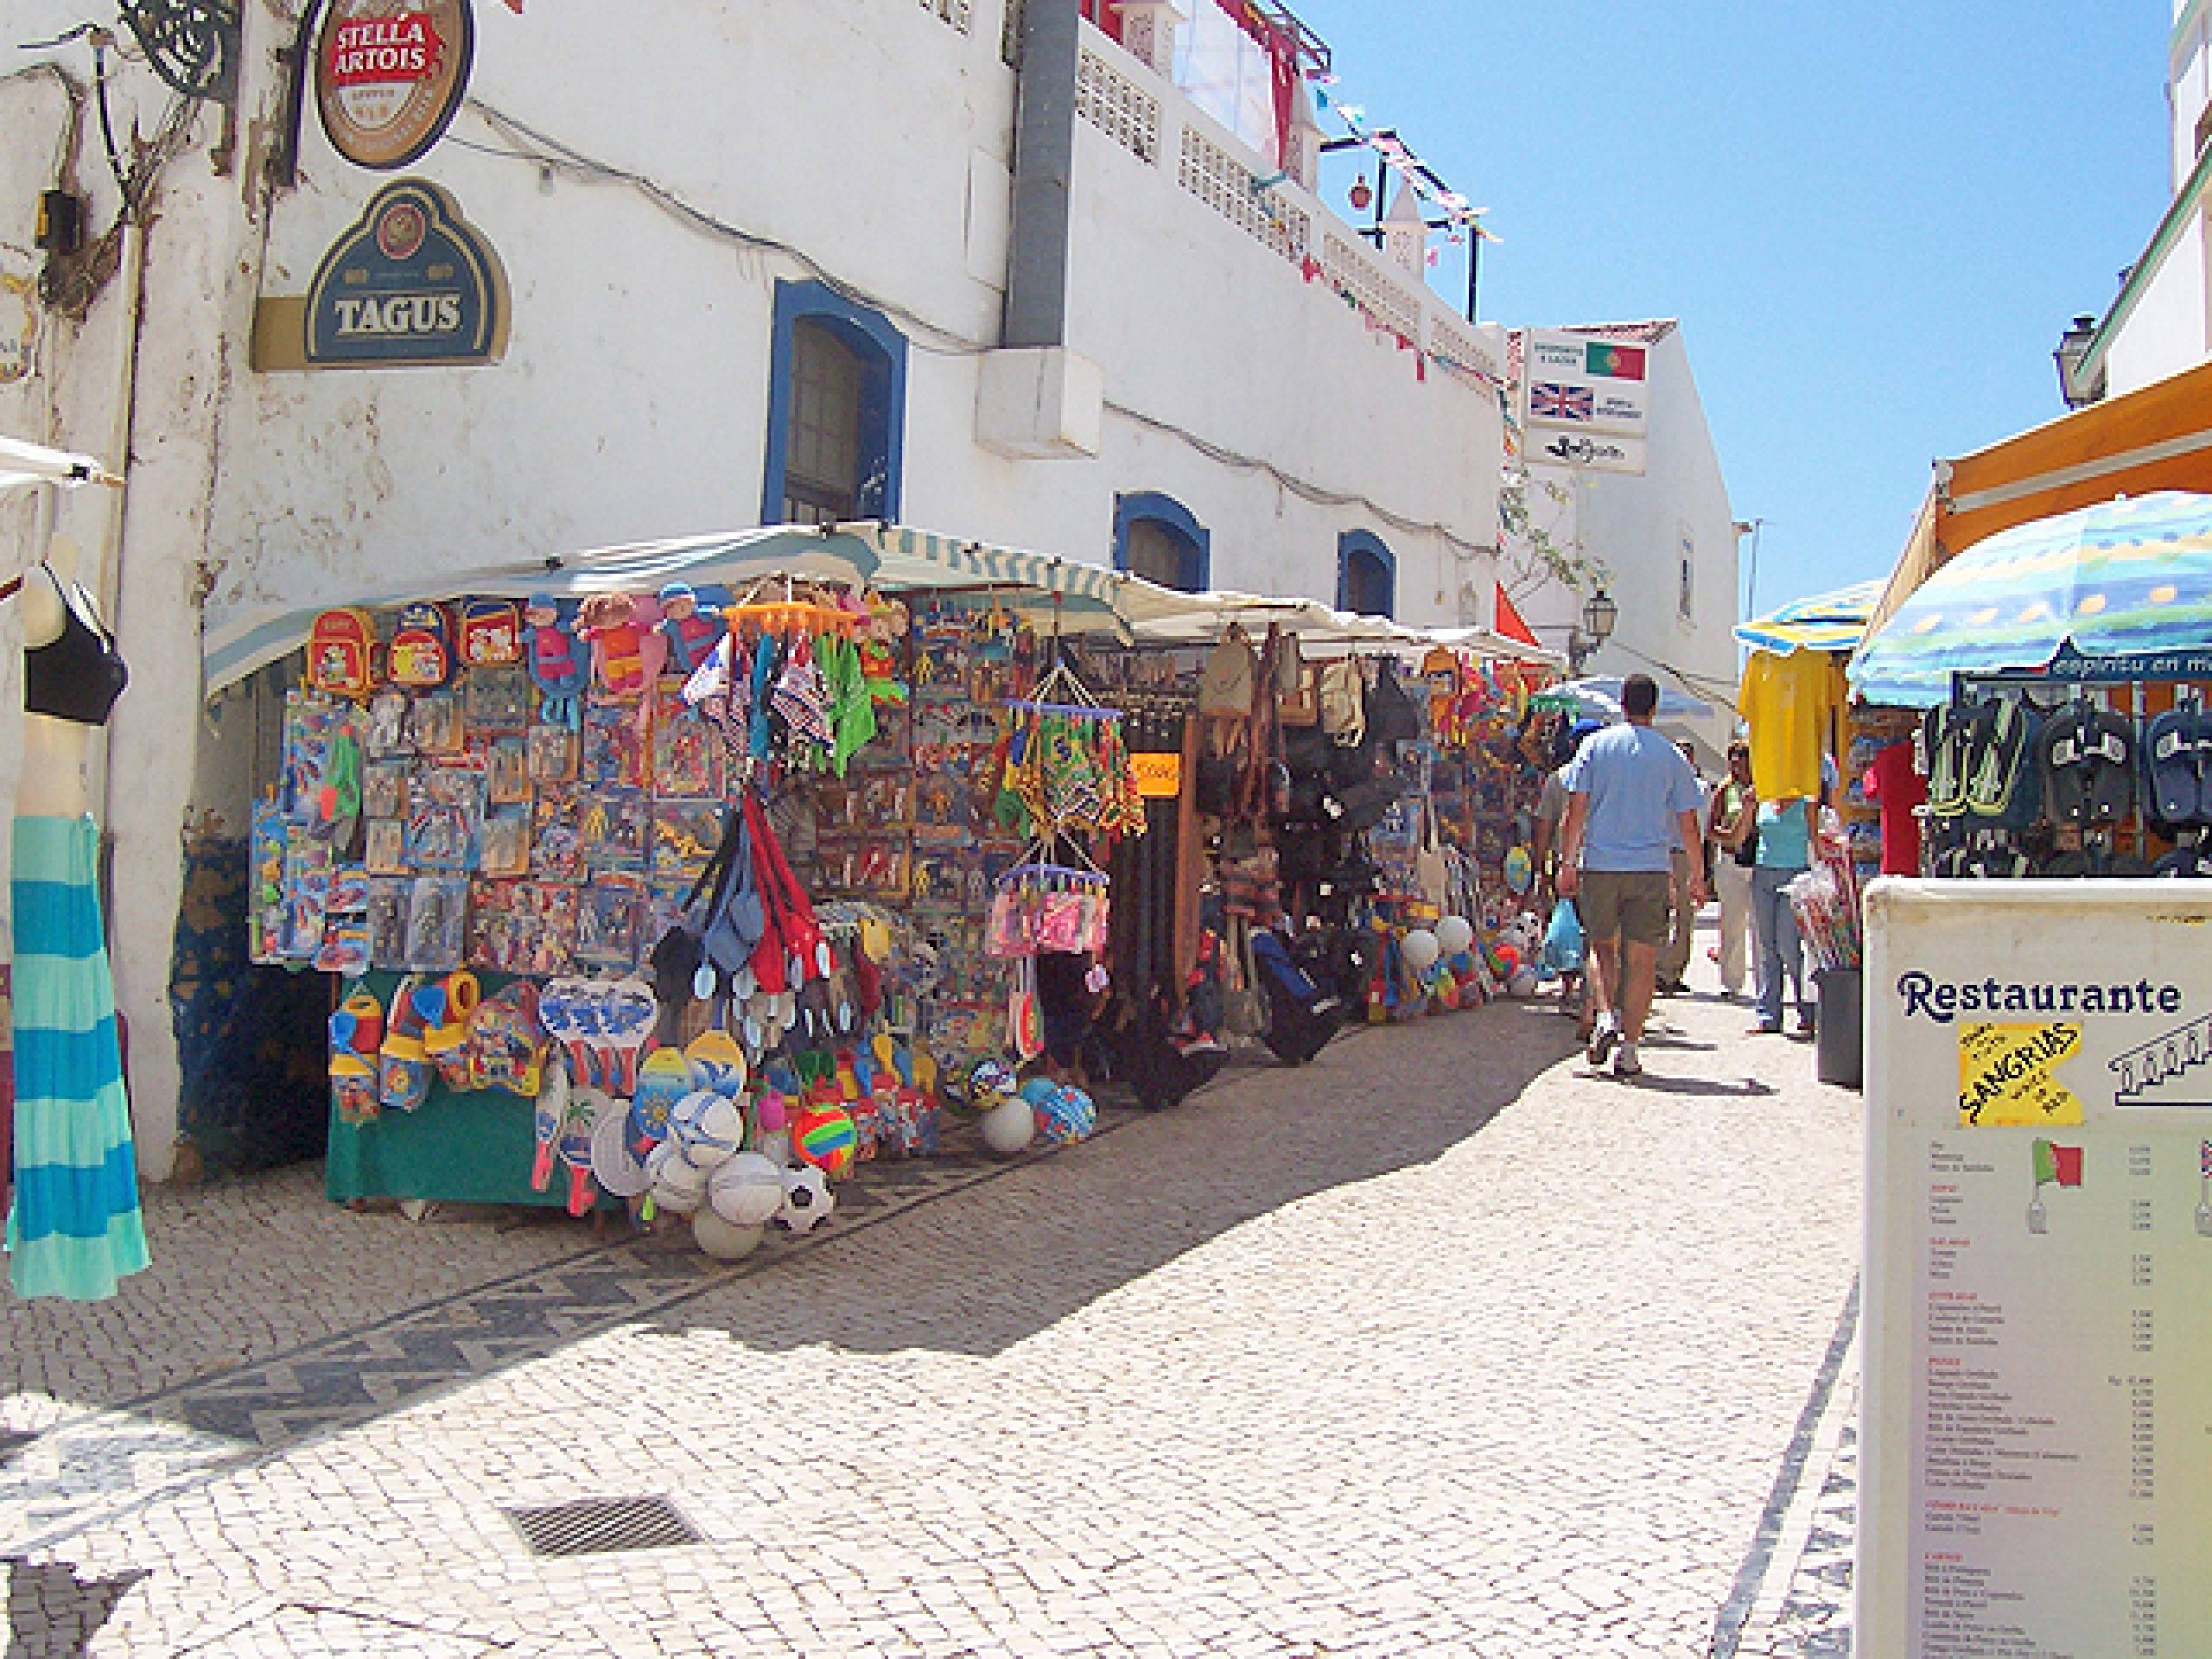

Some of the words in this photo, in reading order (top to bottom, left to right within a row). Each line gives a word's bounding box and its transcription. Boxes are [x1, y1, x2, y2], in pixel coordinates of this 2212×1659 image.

[335, 22, 425, 51] STELLA
[334, 47, 425, 74] ARTOIS
[334, 294, 463, 335] TAGUS
[1897, 970, 2181, 1023] Restaurante
[1958, 1021, 2078, 1125] SANGRIAS
